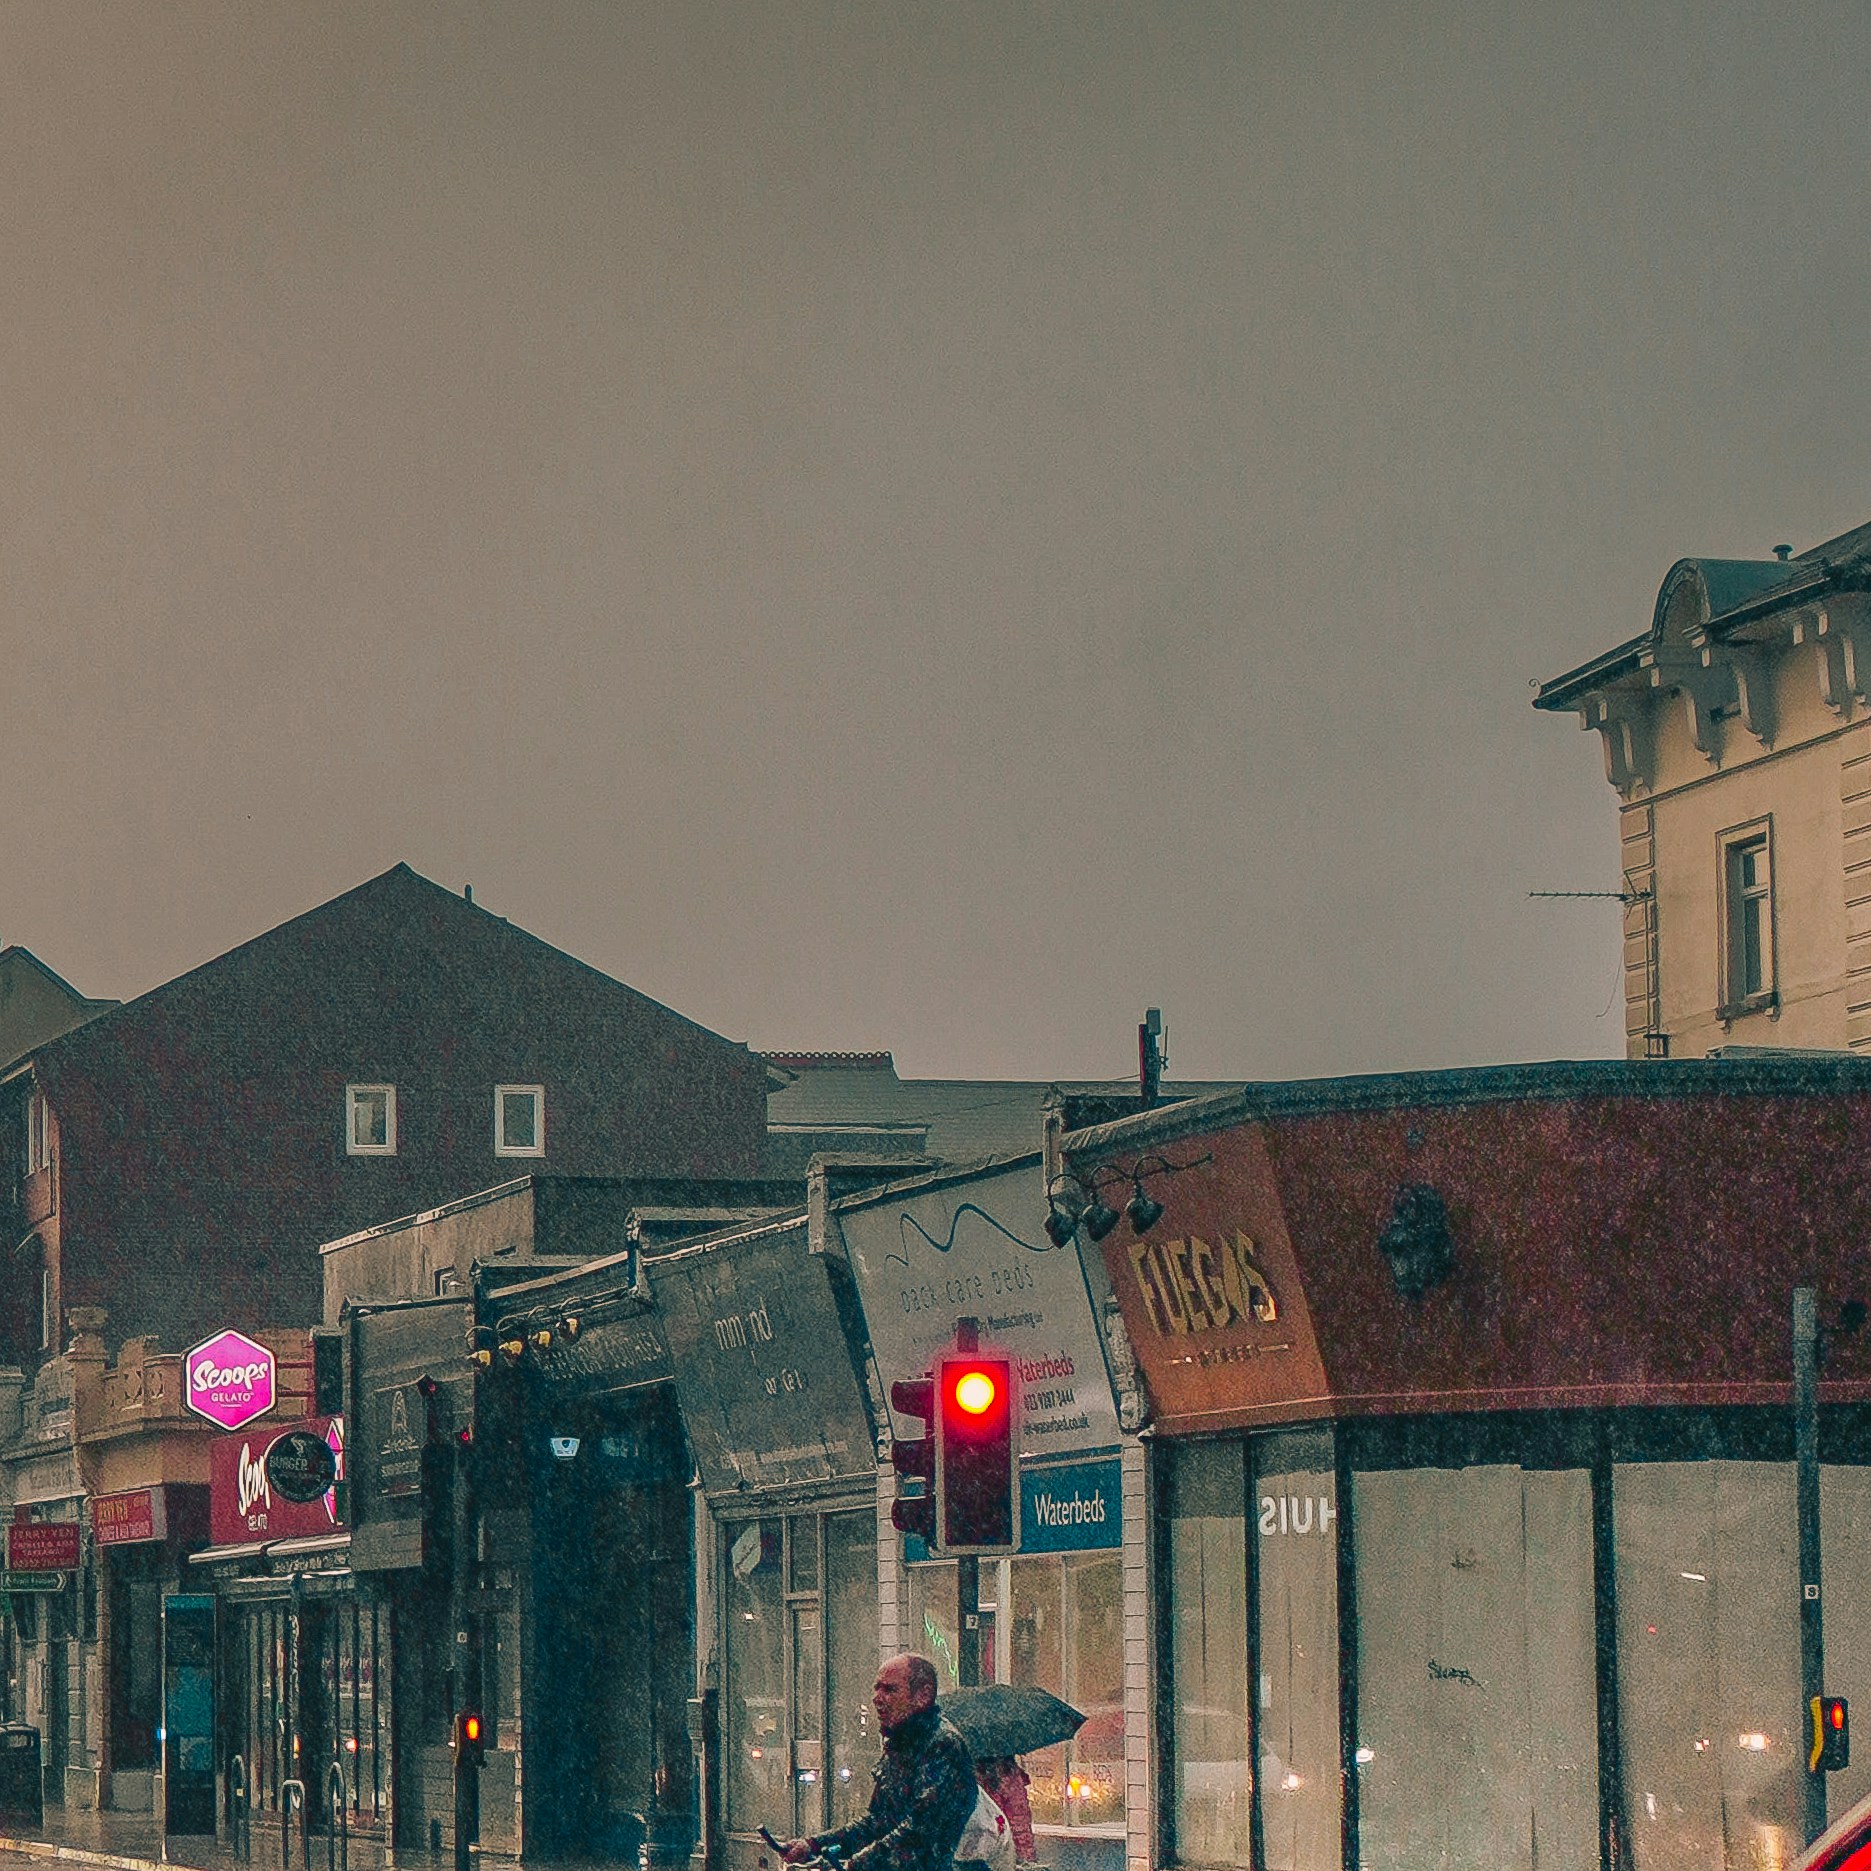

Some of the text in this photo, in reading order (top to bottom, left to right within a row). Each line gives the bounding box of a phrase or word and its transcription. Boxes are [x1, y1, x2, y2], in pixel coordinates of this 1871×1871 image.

[945, 1275, 984, 1305] care
[192, 1360, 268, 1392] Scoops
[211, 1392, 252, 1403] GELATO
[1034, 1488, 1105, 1527] Waterbeds
